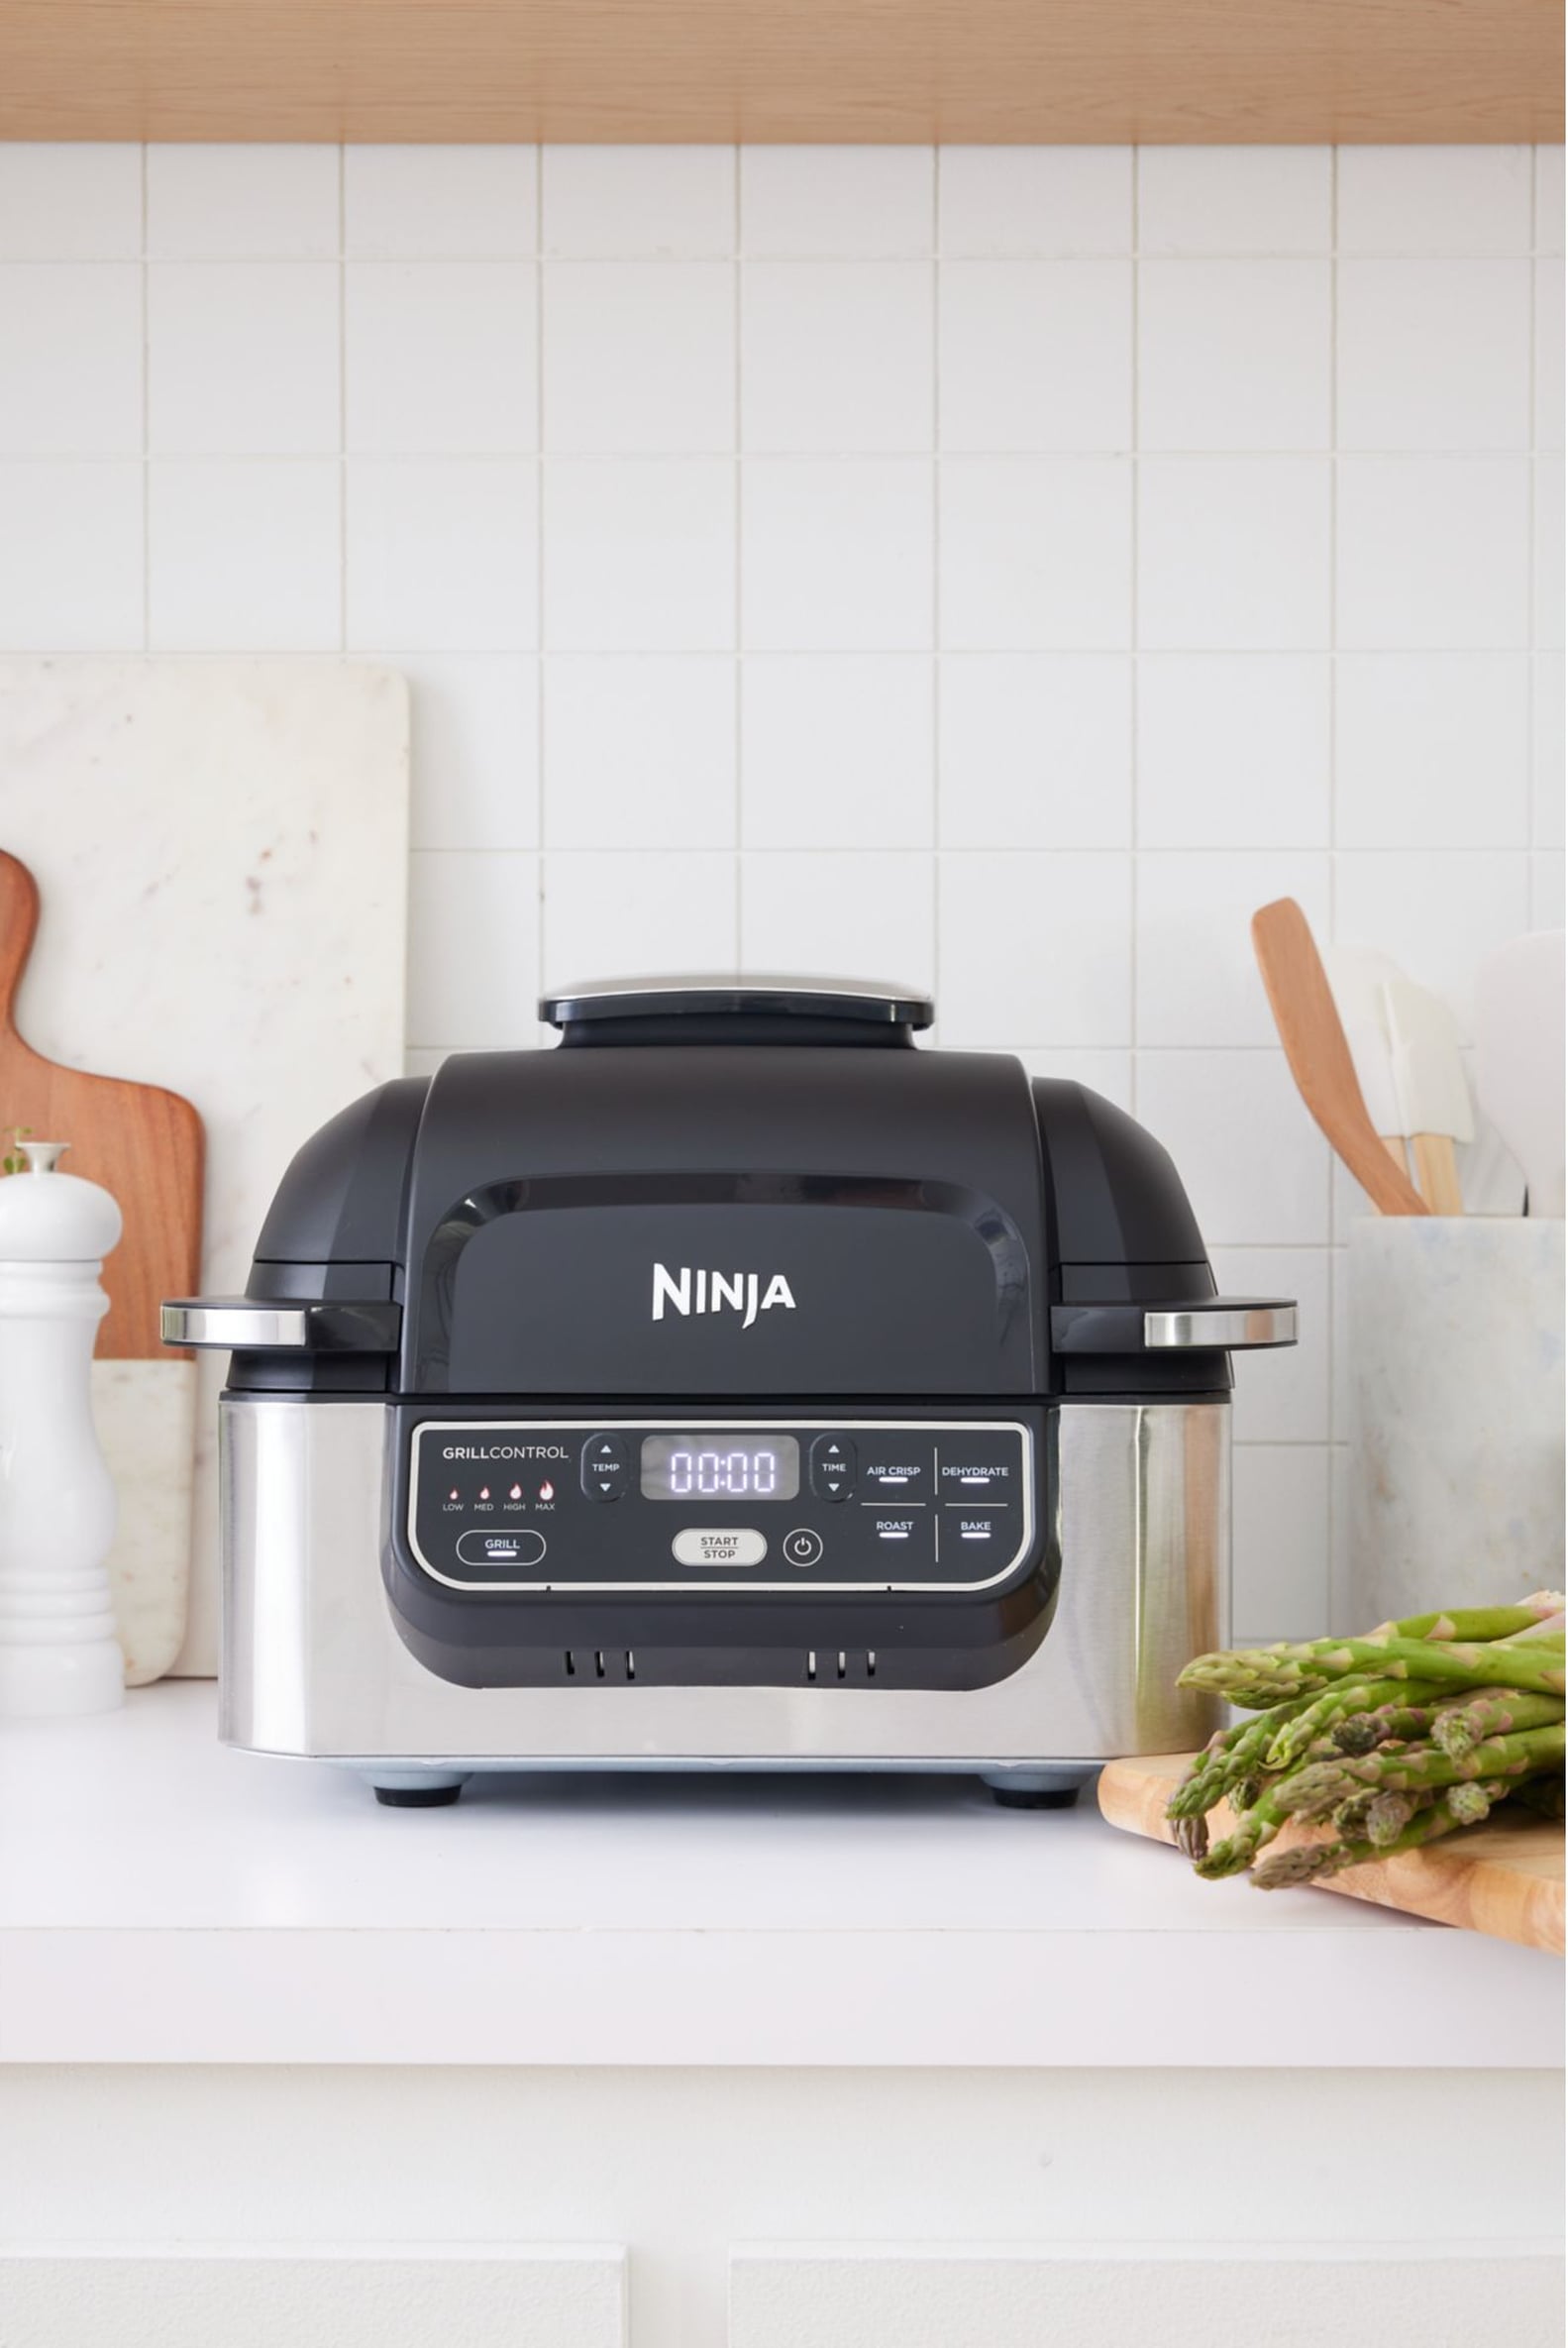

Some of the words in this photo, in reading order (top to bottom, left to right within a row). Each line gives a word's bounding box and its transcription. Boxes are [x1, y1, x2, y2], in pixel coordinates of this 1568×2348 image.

[653, 1263, 795, 1329] NINJA
[443, 1446, 569, 1459] GRILLCONTROL
[591, 1463, 620, 1472] TEMP
[672, 1452, 775, 1492] 00:00
[821, 1463, 846, 1472] TIME
[867, 1466, 886, 1476] AIR
[888, 1466, 921, 1476] CRISP
[941, 1466, 1008, 1476] DEHYDRATE
[876, 1522, 913, 1531] ROAST
[960, 1522, 992, 1531] BAKE
[485, 1539, 520, 1549] GRILL
[701, 1537, 739, 1546] START
[703, 1548, 736, 1559] STOP
